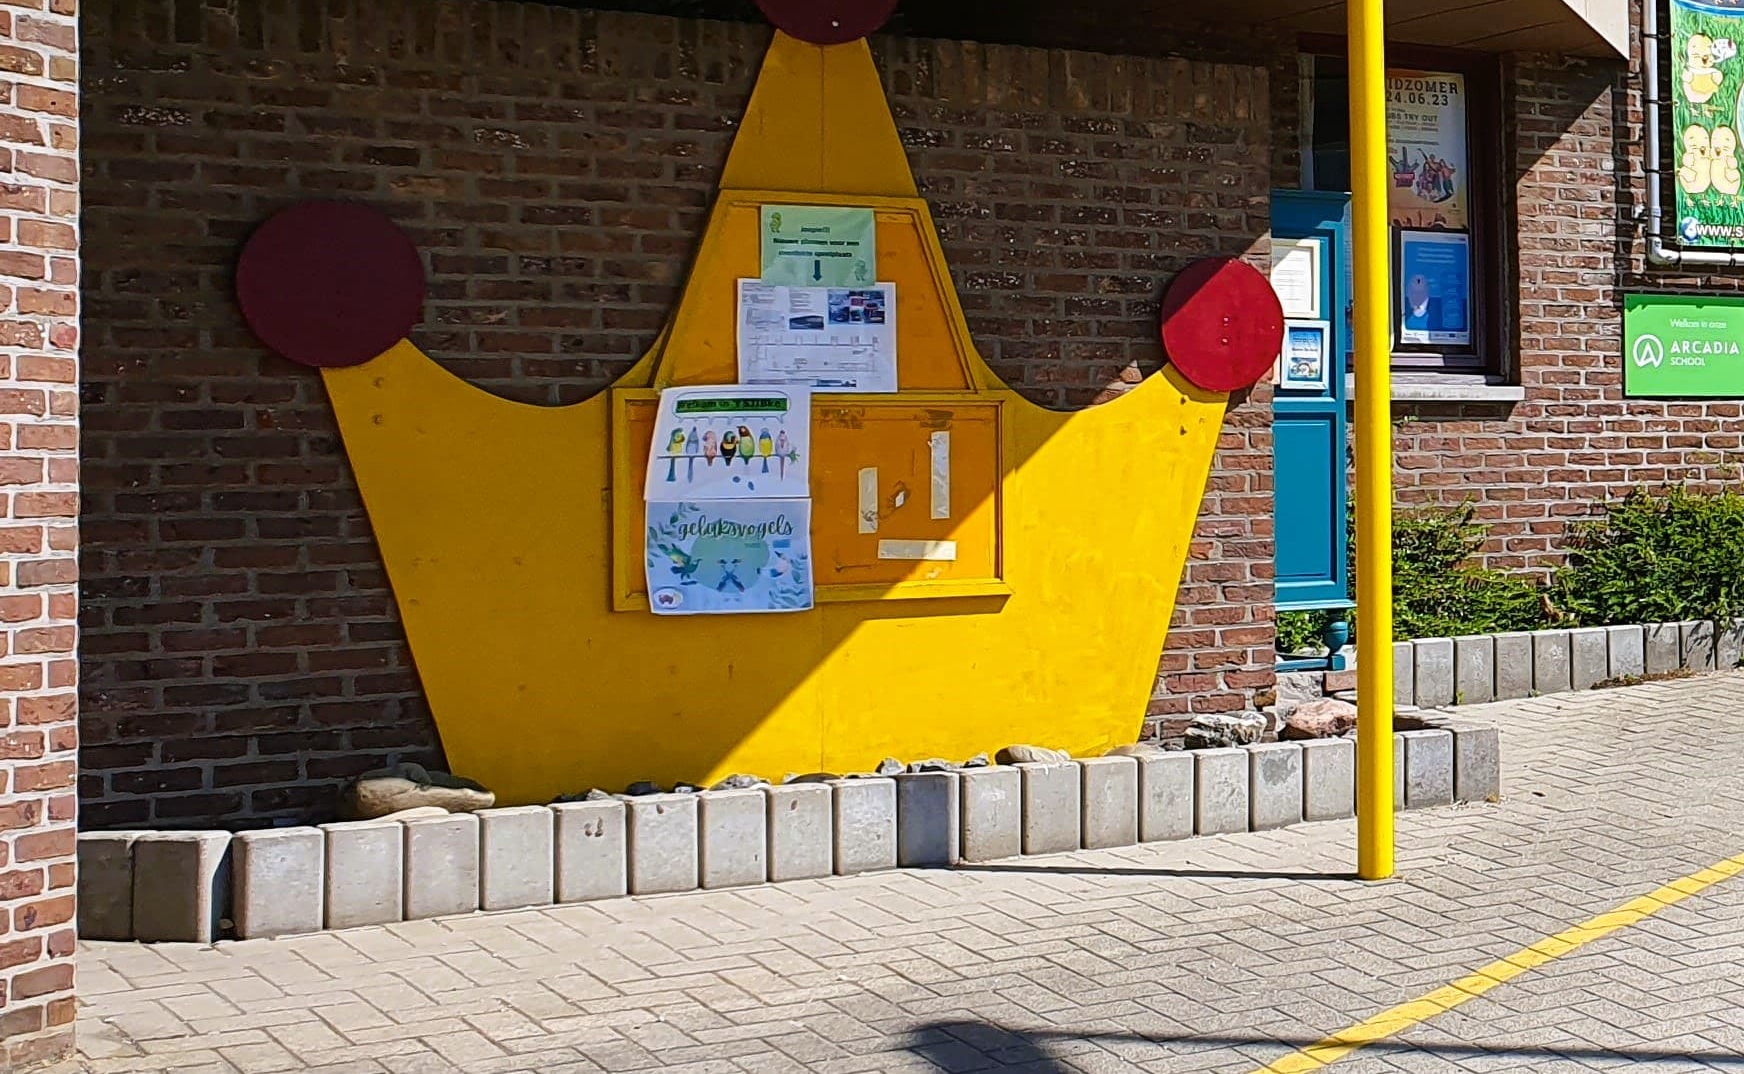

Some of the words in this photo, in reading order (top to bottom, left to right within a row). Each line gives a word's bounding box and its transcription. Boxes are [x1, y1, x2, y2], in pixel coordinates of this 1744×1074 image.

[1386, 77, 1459, 95] IDZOMER
[1385, 90, 1449, 106] 24.06.23
[1670, 340, 1740, 355] ARCADIA
[1670, 356, 1706, 367] SCHOOL
[678, 513, 794, 542] geluksvogels
